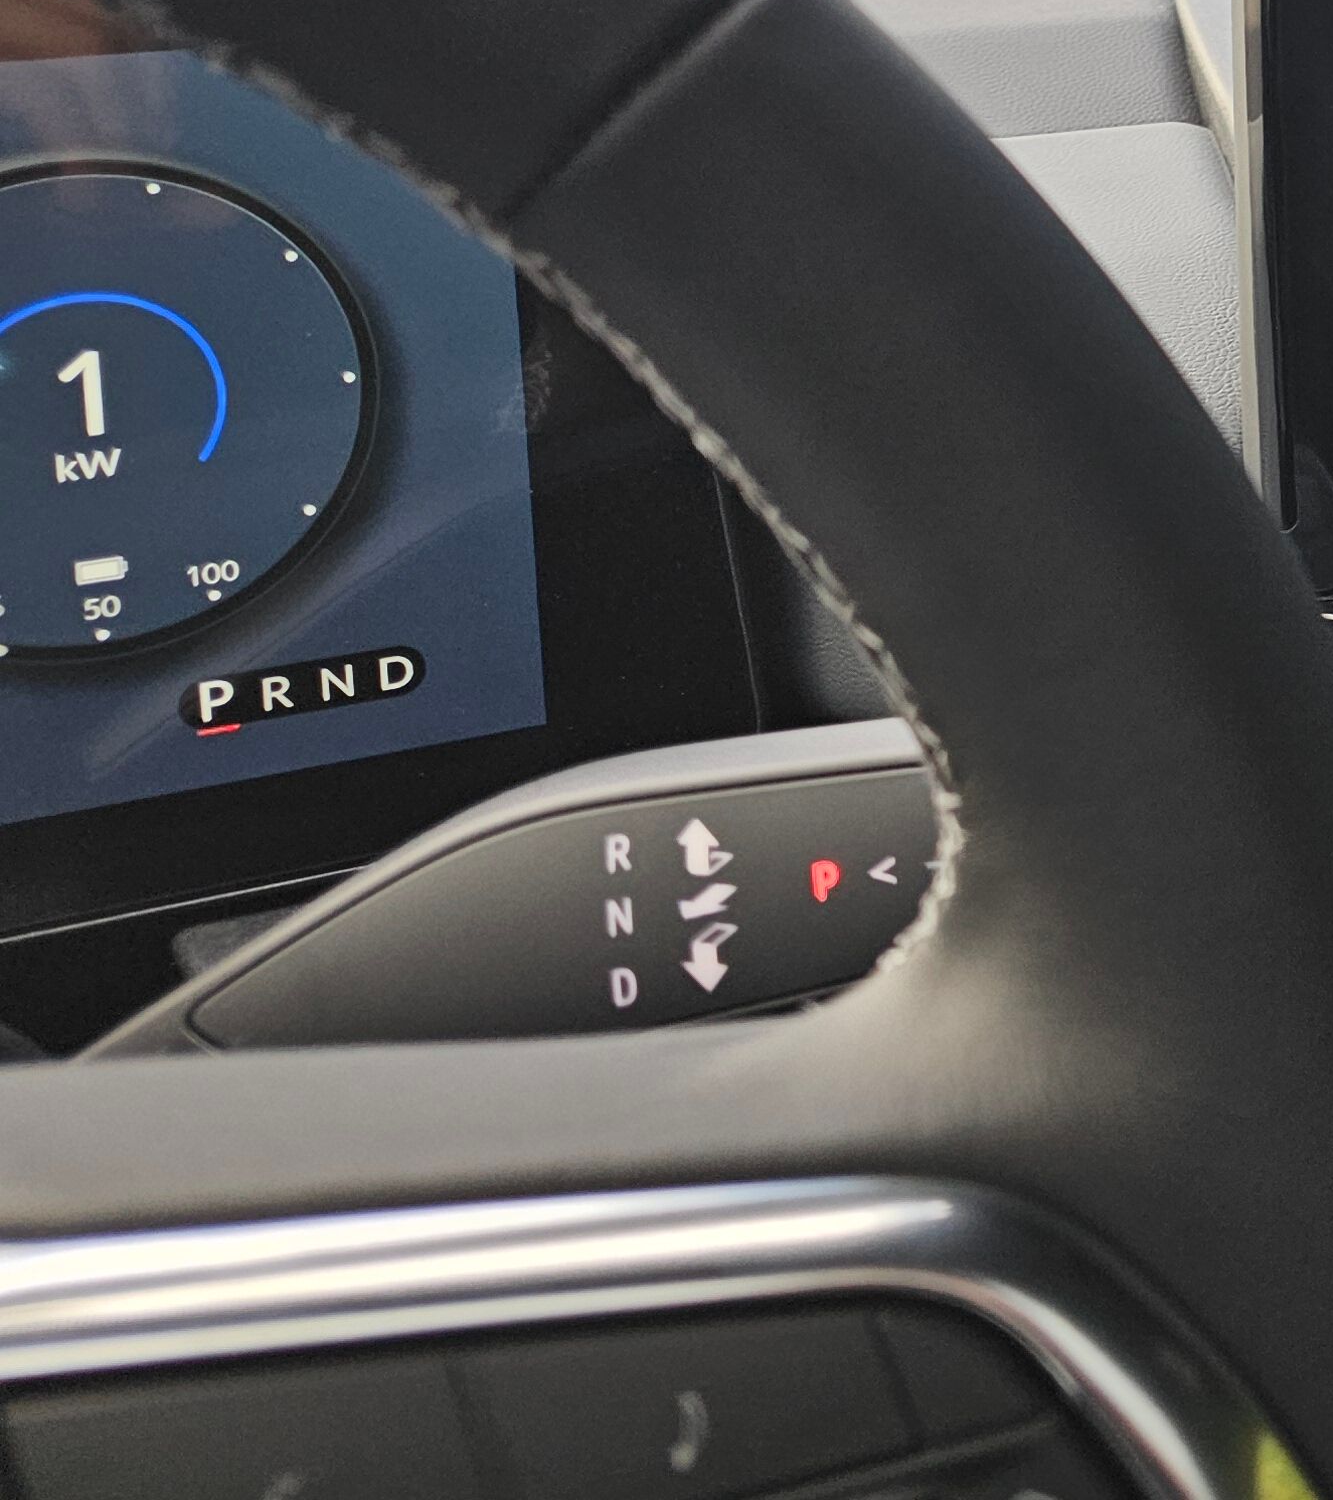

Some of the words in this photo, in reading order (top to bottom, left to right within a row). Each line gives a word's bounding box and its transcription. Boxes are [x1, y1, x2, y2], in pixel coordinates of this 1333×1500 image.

[57, 350, 104, 436] 1
[54, 448, 121, 484] kW
[186, 559, 241, 587] 100
[83, 594, 122, 621] 50
[199, 679, 235, 723] P
[261, 675, 295, 712] R
[320, 663, 355, 702] N
[378, 655, 414, 691] D
[604, 833, 632, 875] R
[810, 859, 840, 903] P
[605, 897, 634, 938] N
[609, 966, 638, 1008] D
